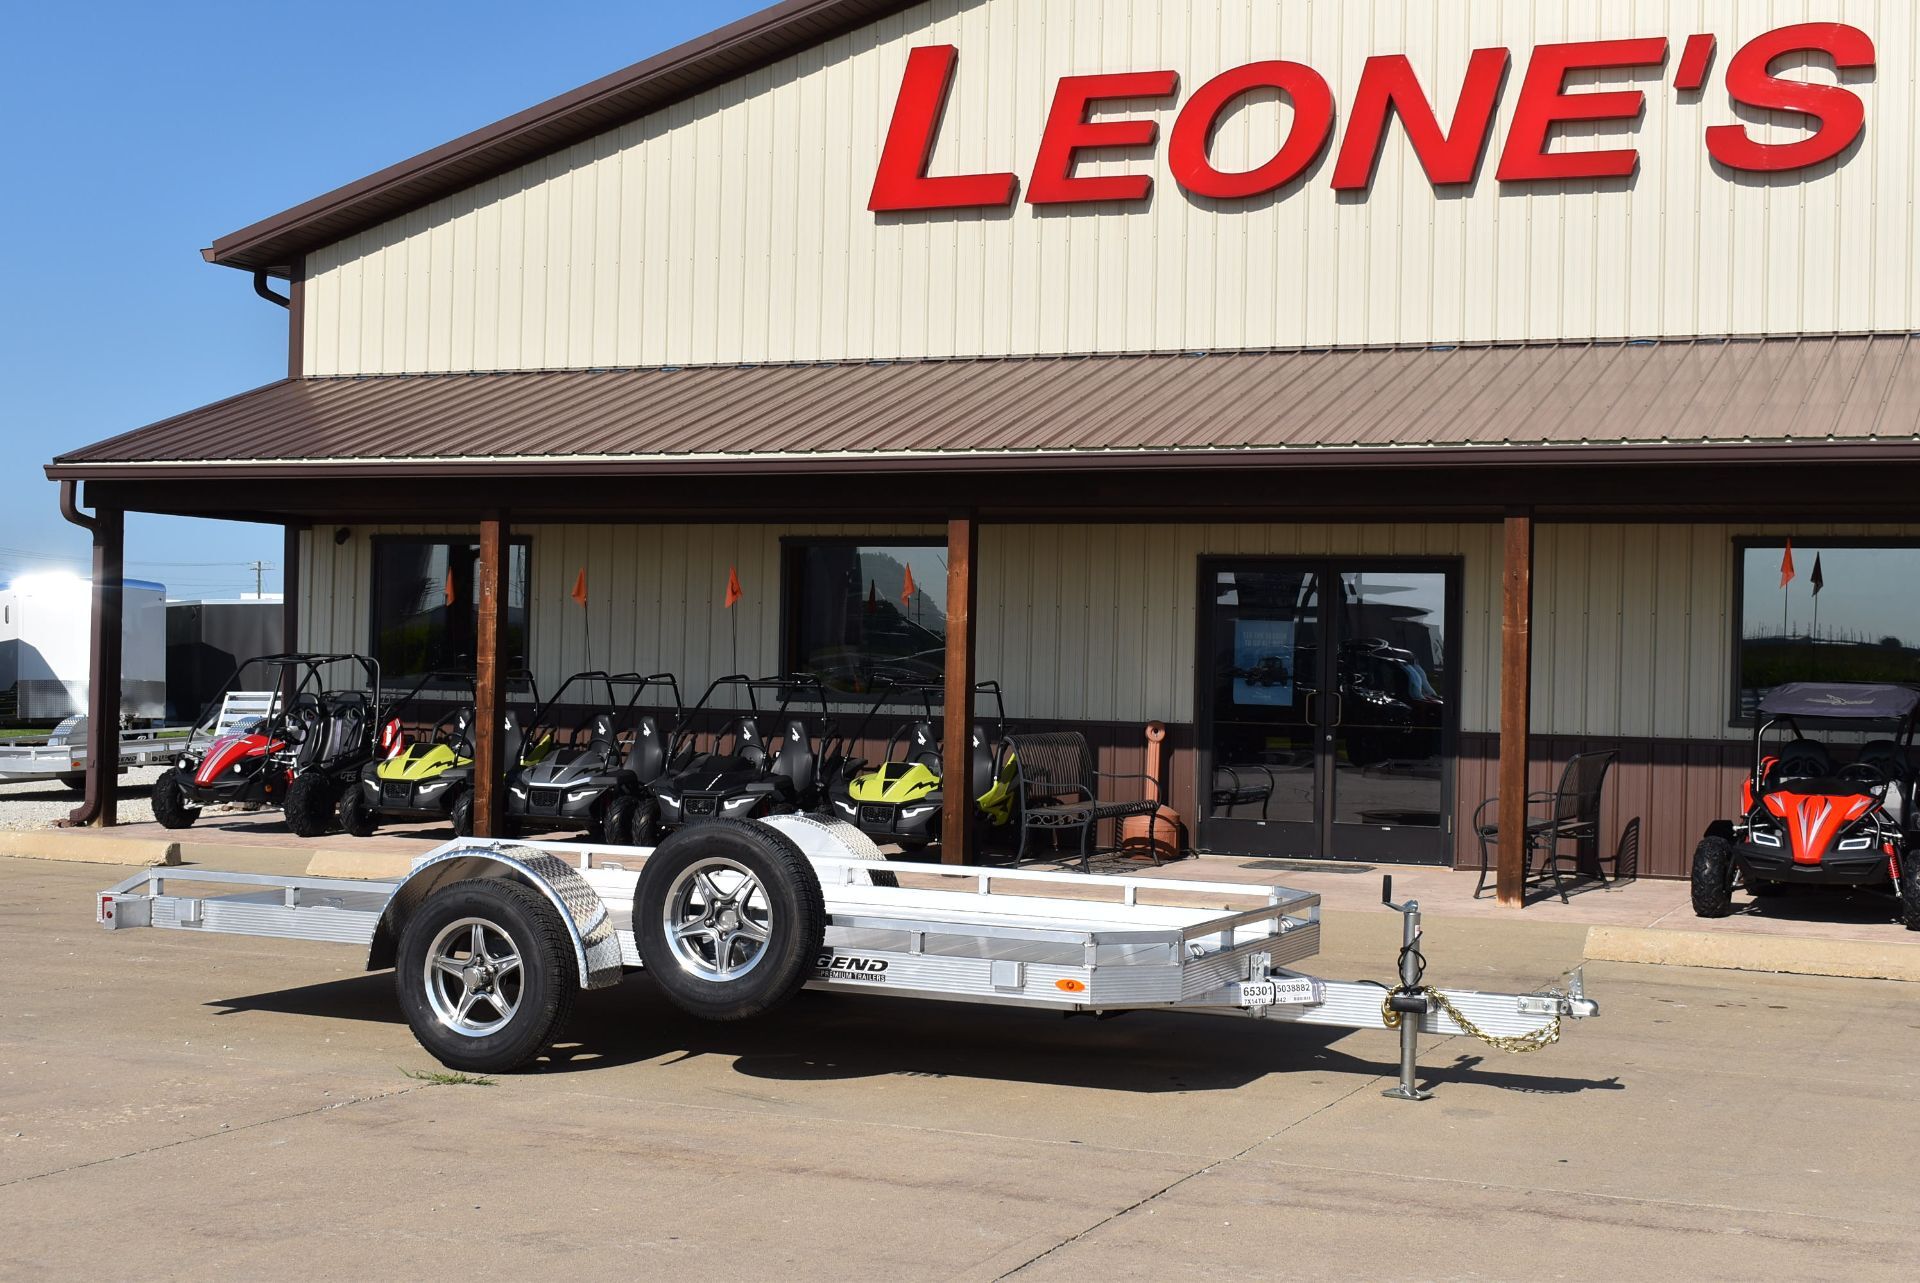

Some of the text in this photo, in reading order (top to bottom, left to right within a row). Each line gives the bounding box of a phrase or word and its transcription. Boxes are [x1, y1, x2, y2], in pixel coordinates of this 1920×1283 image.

[867, 22, 1877, 212] LEONE'S
[815, 954, 889, 972] GEND
[820, 971, 886, 982] PREMIUM TRAILERS
[1243, 984, 1311, 996] 65301 5038882
